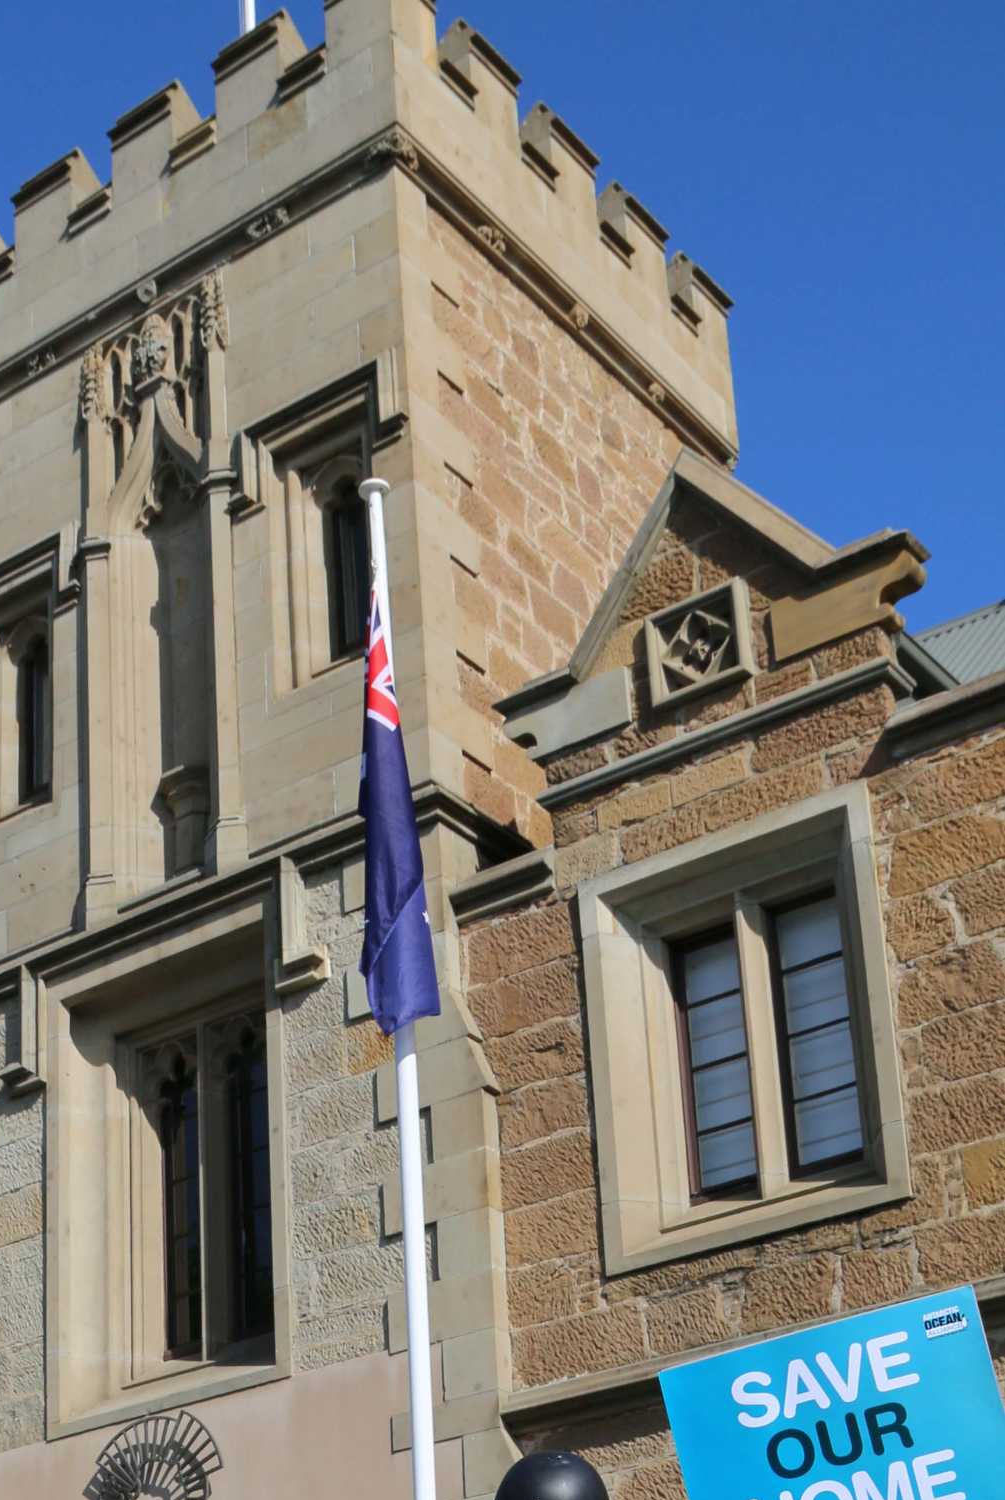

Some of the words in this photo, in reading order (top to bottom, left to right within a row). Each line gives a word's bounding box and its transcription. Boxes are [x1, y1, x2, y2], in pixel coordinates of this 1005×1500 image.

[924, 1312, 962, 1330] OCEAN
[731, 1331, 920, 1428] SAVE
[766, 1402, 914, 1479] OUR
